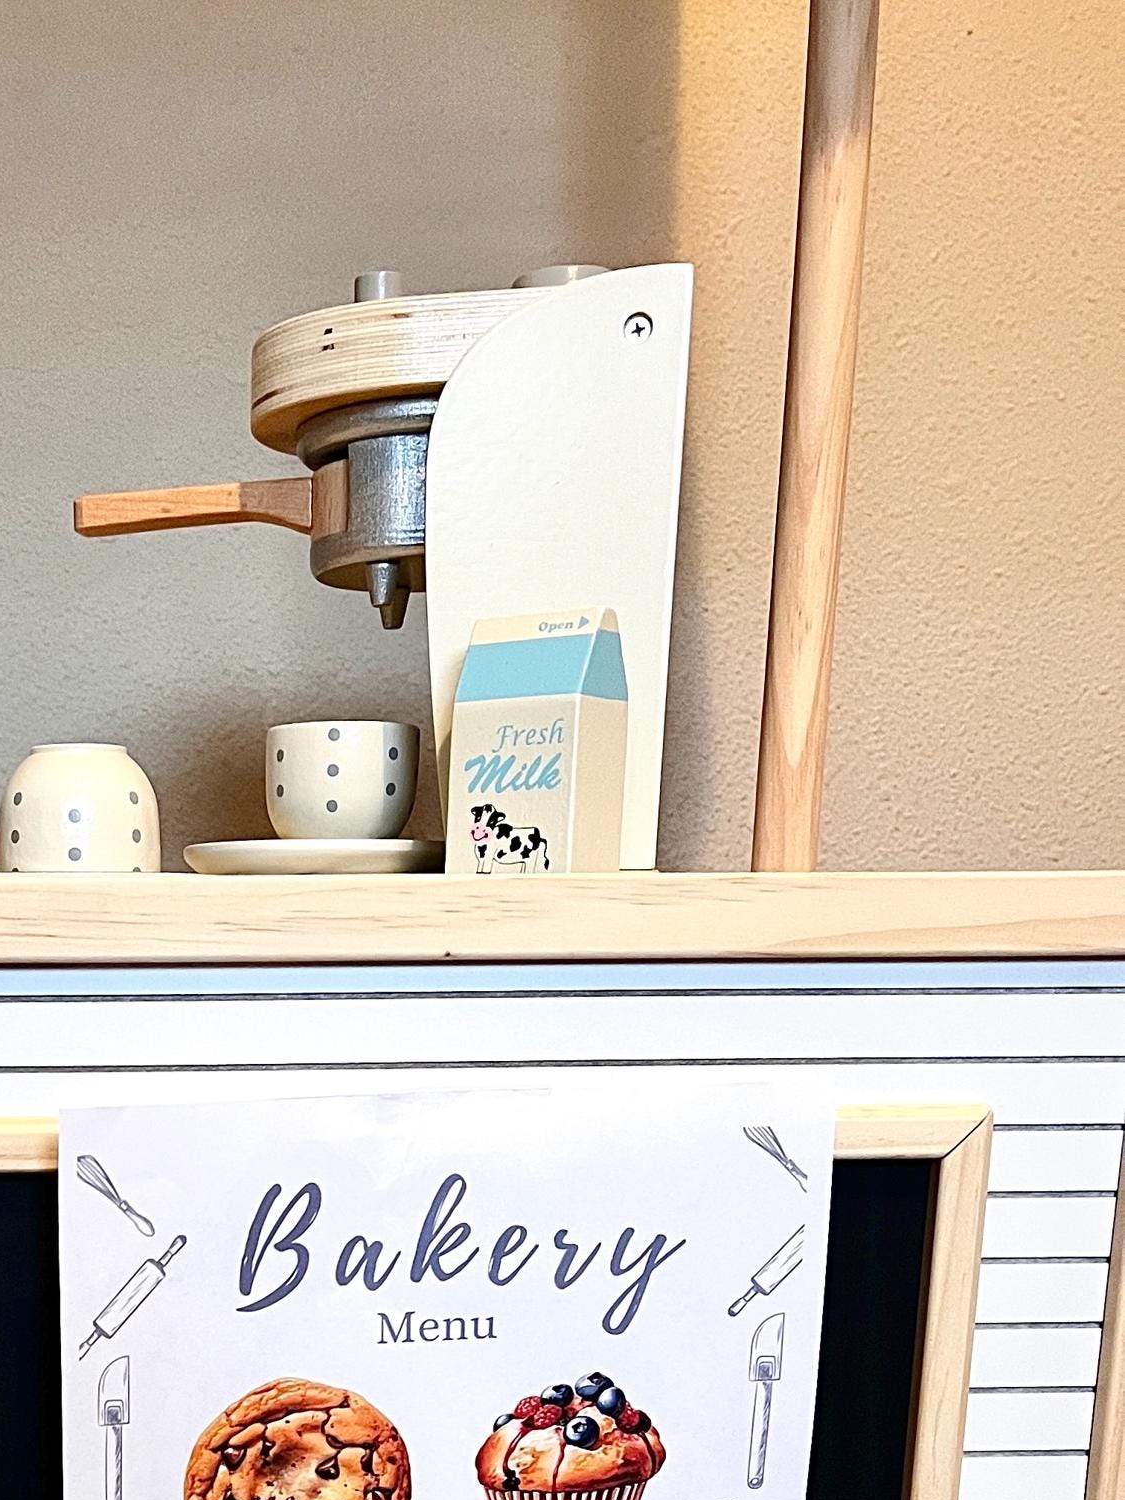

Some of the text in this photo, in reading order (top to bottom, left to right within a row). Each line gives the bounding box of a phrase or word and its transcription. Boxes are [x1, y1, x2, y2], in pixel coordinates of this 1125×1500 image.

[538, 620, 574, 633] Open
[492, 718, 564, 753] Fresh
[463, 752, 562, 794] Milk
[236, 1173, 686, 1336] Bakery
[377, 1311, 497, 1344] Menu
